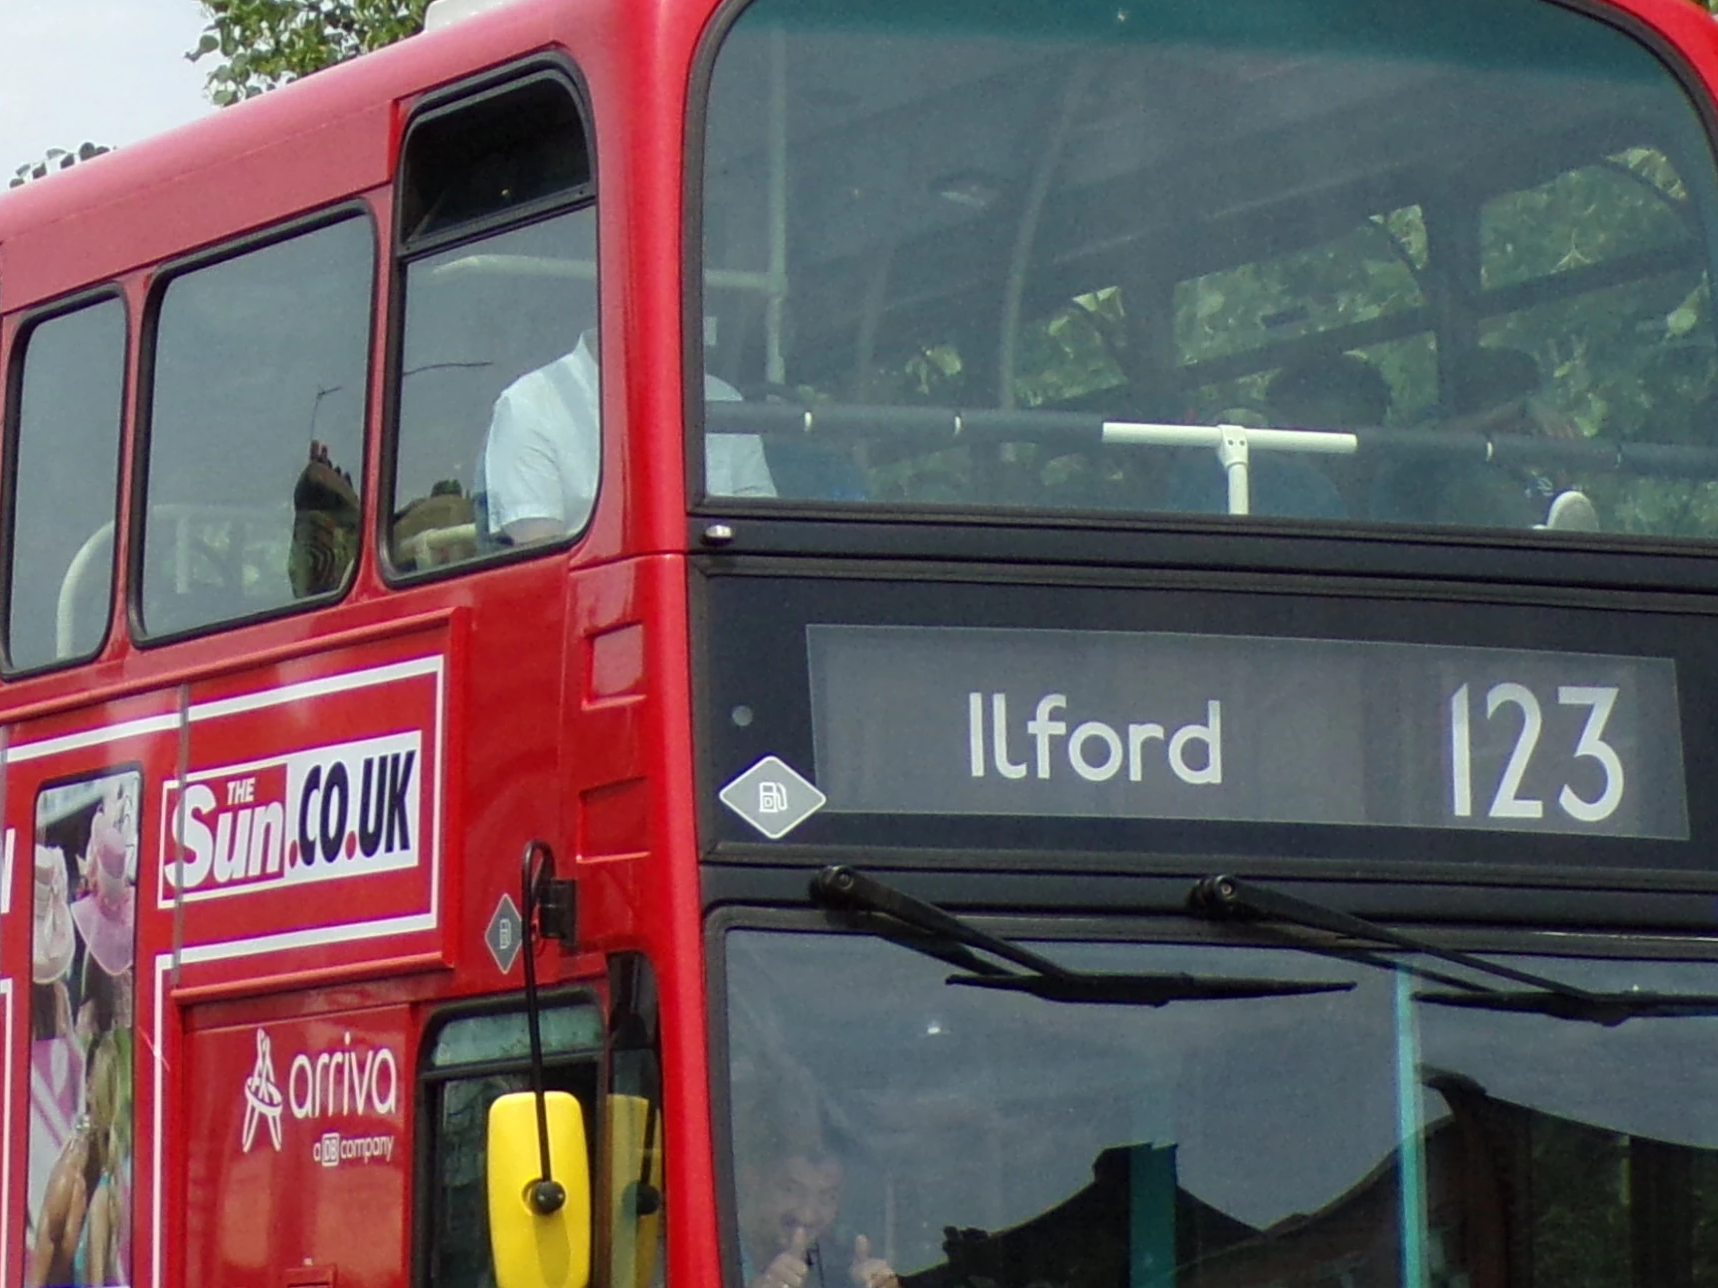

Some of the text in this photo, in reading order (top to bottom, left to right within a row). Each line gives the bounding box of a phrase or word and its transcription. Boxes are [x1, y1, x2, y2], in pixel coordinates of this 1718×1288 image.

[967, 682, 1626, 822] Ilford 123
[226, 777, 256, 806] THE
[289, 1031, 397, 1119] arriva
[313, 1142, 321, 1162] a
[340, 1135, 395, 1164] company
